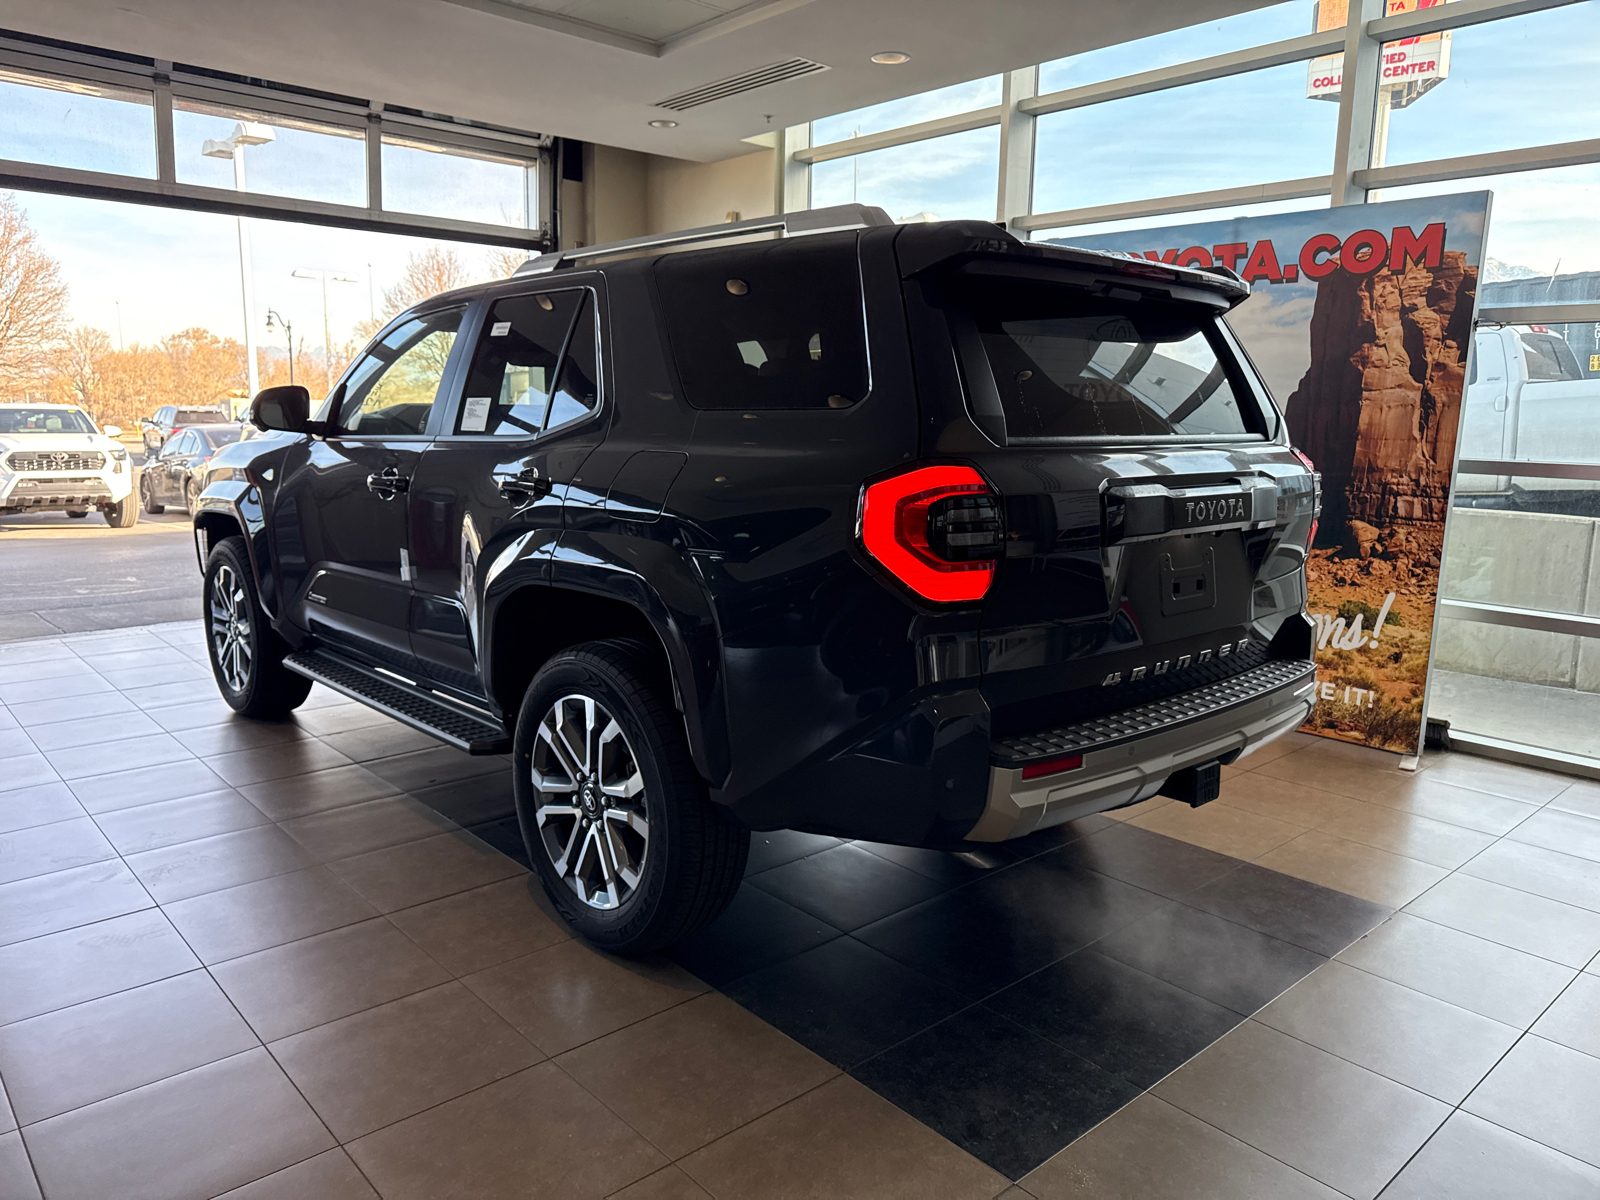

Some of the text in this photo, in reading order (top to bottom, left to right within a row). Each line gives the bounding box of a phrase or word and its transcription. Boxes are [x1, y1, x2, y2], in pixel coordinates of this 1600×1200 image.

[1389, 1, 1406, 12] TA
[1382, 51, 1407, 65] IED
[1312, 60, 1436, 89] COLL CENTER
[1185, 498, 1245, 523] TOYOTA
[1102, 638, 1249, 687] 4RUNNER
[1344, 686, 1375, 709] IT!
